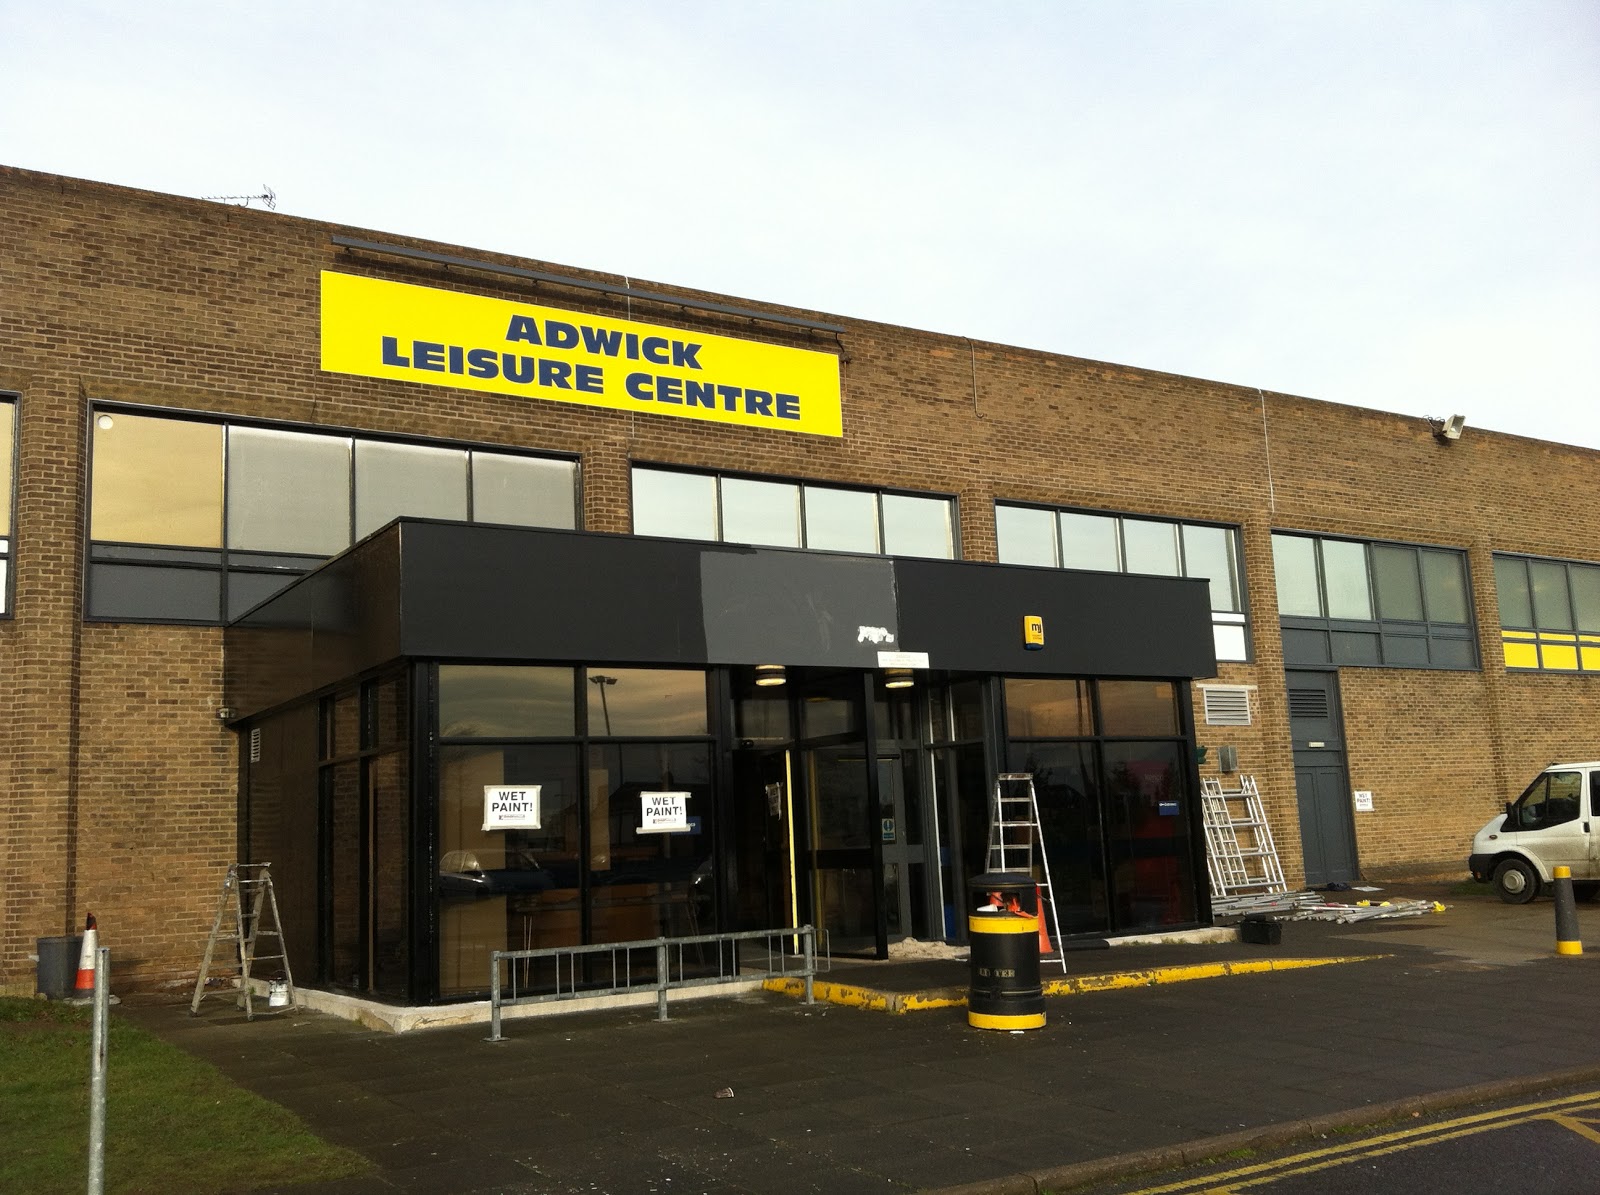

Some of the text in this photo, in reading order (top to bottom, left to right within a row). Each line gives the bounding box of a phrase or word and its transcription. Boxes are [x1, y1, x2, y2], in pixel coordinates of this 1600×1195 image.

[505, 314, 703, 370] ADWICK
[381, 335, 801, 420] LEISURE CENTRE
[498, 791, 526, 801] WET
[651, 796, 676, 806] WET
[491, 802, 533, 812] PAINT!
[646, 806, 683, 817] PAINT!
